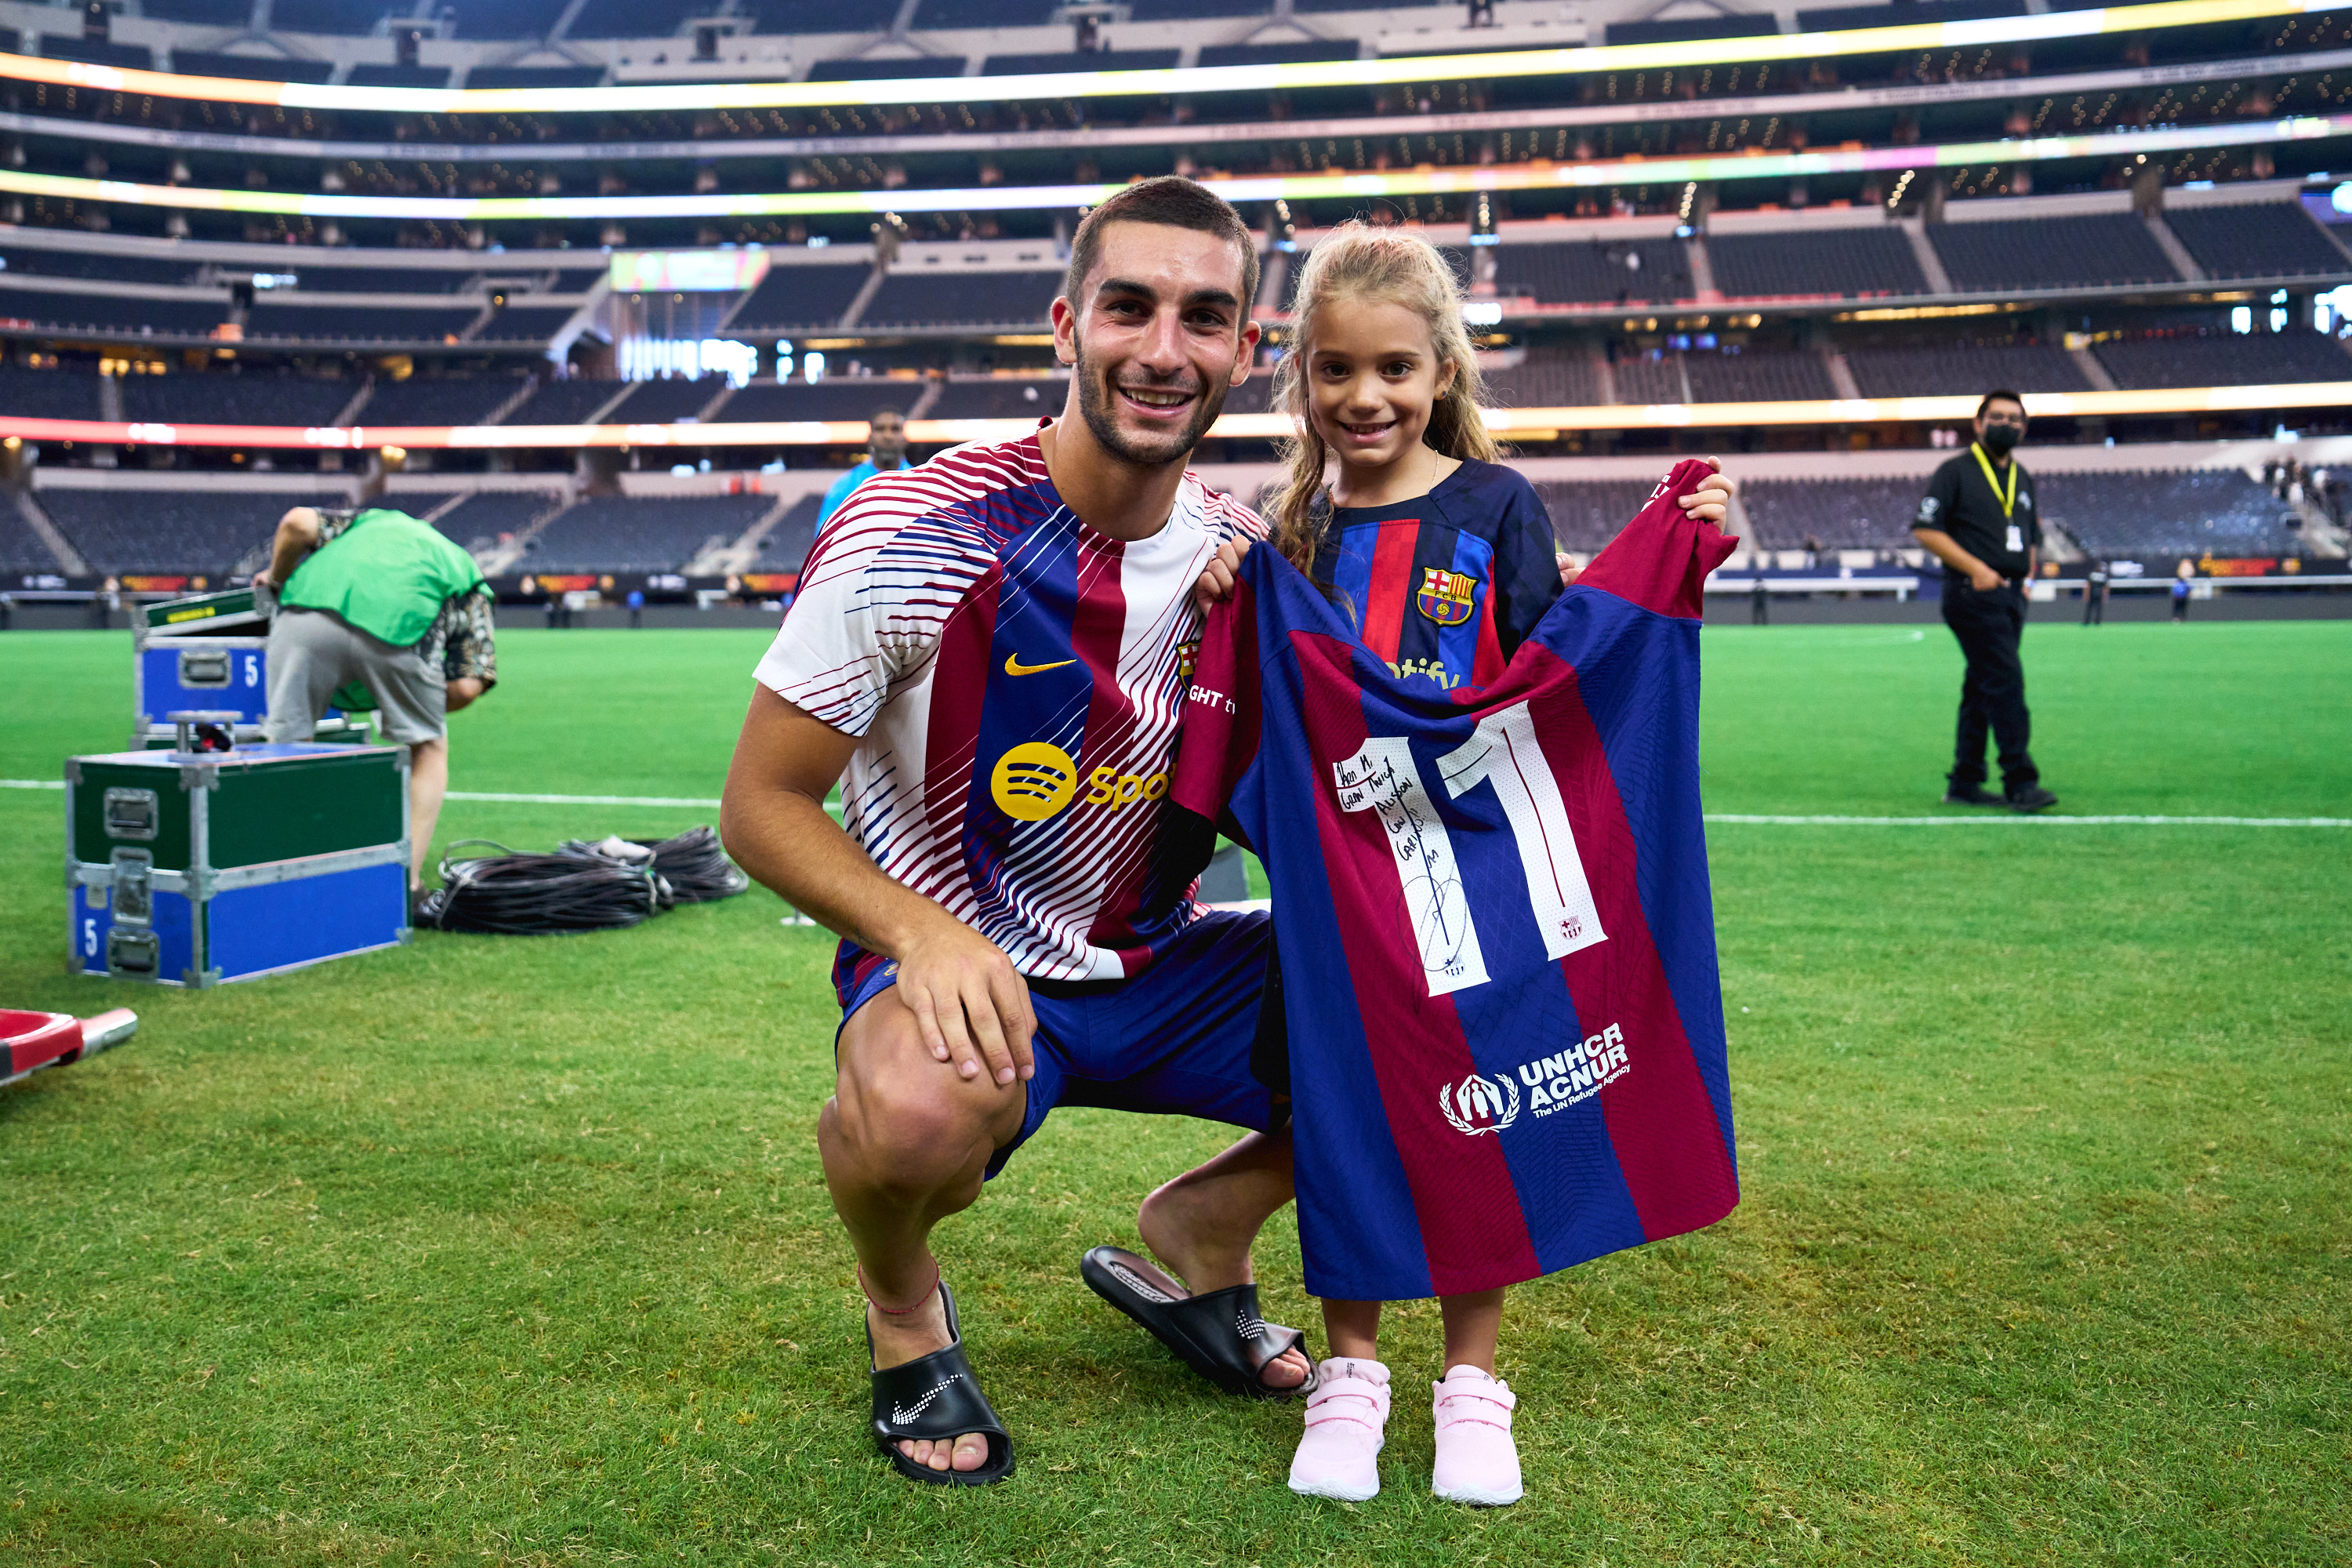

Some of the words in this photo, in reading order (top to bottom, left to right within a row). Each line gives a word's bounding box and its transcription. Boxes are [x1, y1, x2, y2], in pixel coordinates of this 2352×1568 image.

[1435, 590, 1456, 601] FCB
[244, 655, 258, 687] 5
[83, 917, 97, 956] 5
[1518, 1022, 1624, 1086] UNHCR
[1530, 1044, 1628, 1109] ACNUR
[1533, 1106, 1552, 1118] The
[1552, 1099, 1568, 1111] UN
[1567, 1082, 1602, 1105] Refugee
[1602, 1063, 1630, 1086] Agency
